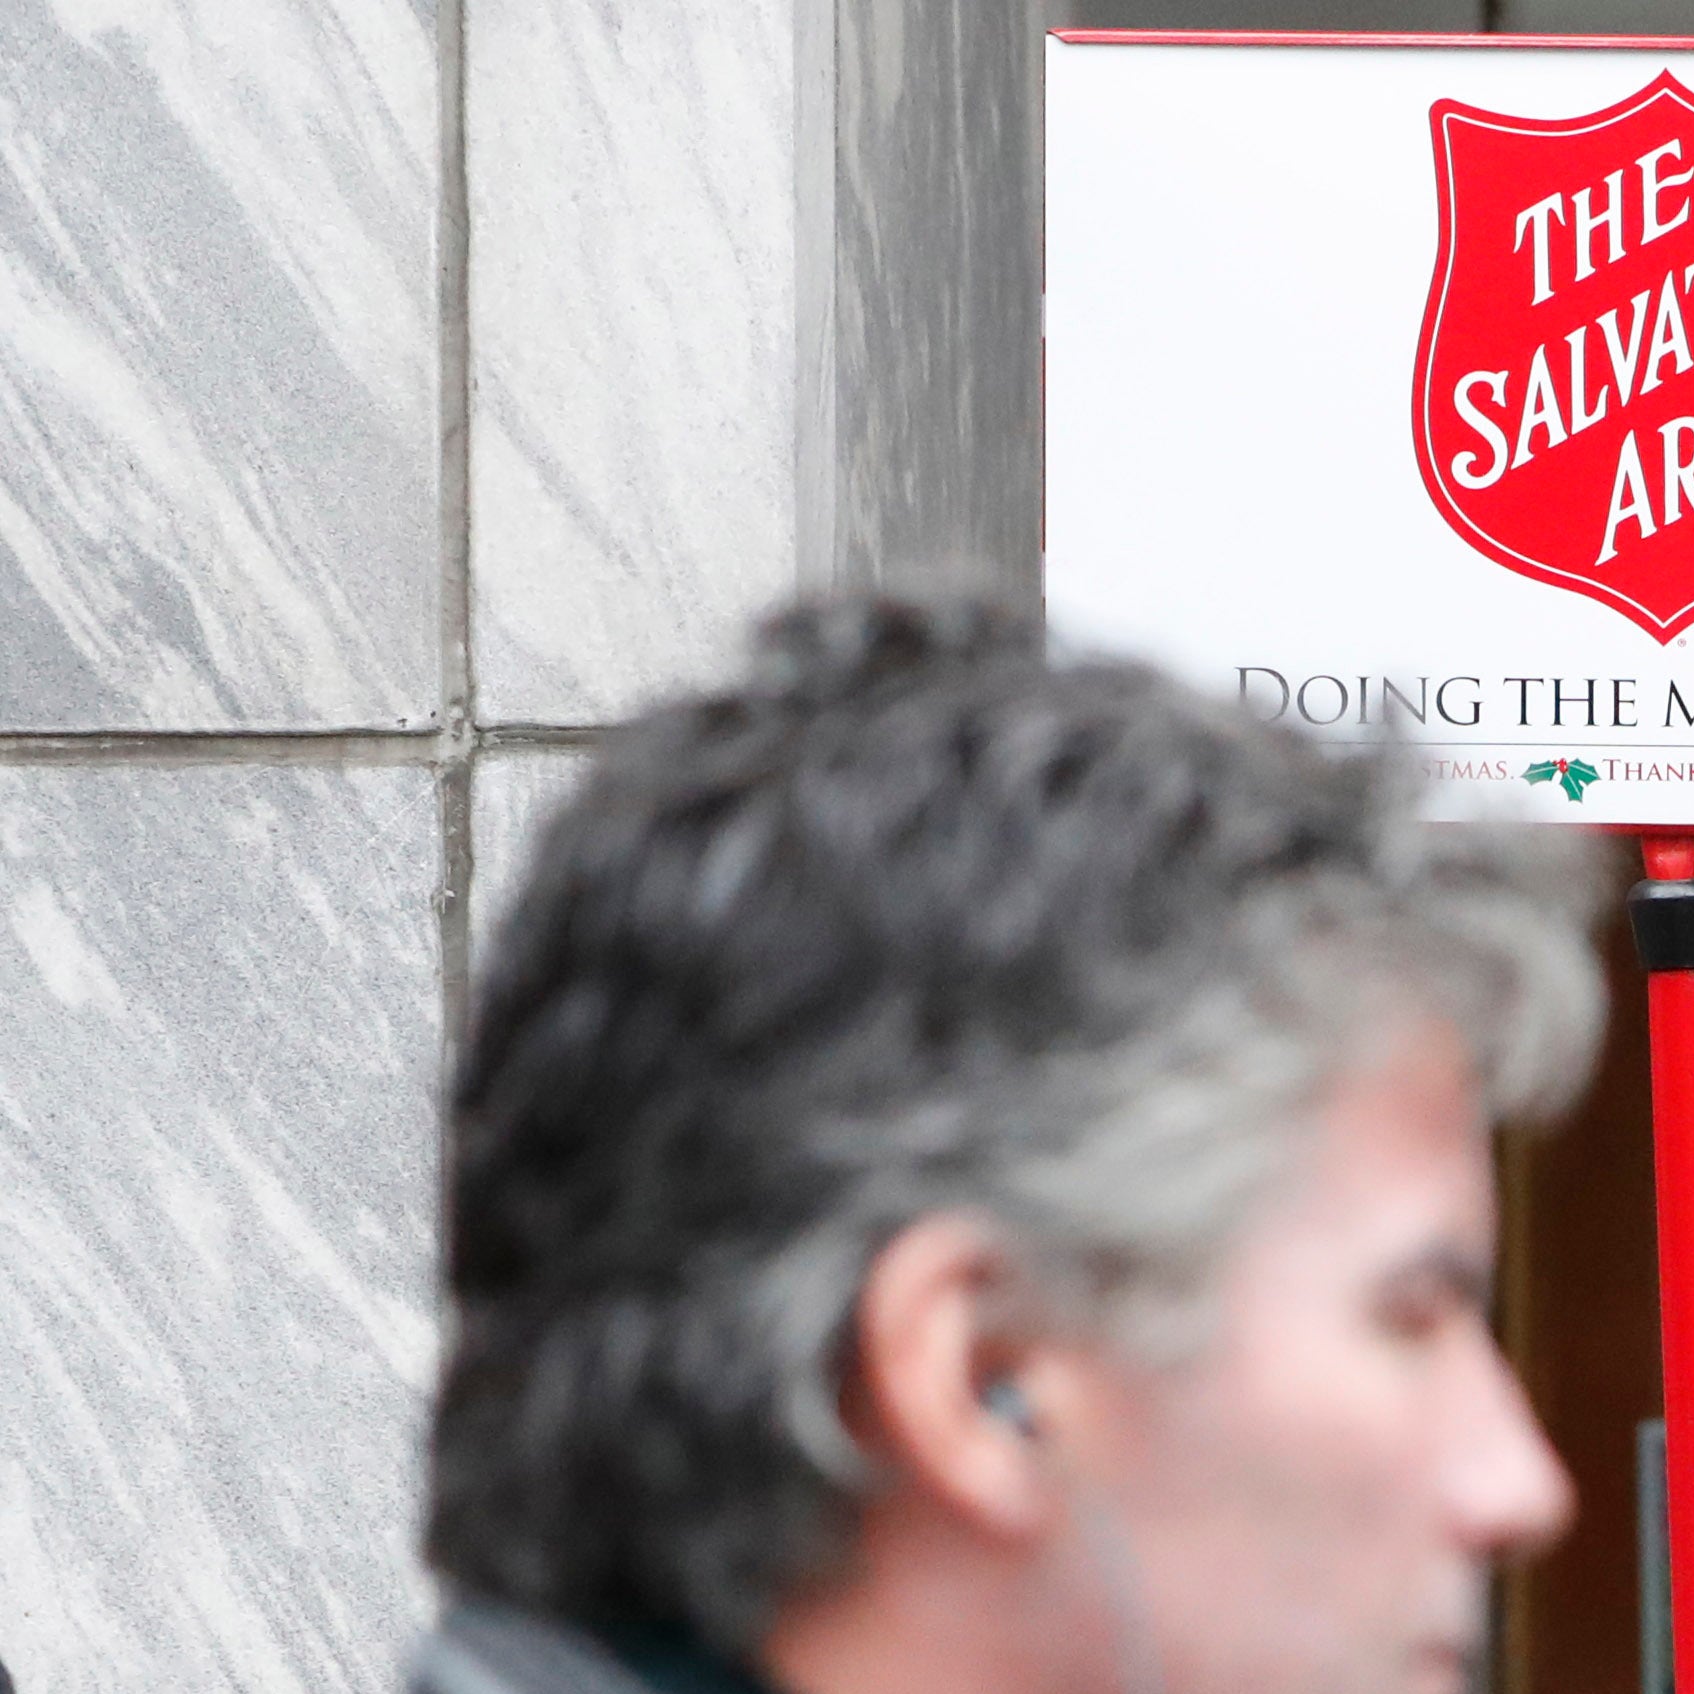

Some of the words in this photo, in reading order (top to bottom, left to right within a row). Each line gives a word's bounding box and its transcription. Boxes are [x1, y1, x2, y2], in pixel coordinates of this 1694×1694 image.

[1513, 138, 1694, 306] THE
[1234, 666, 1482, 726] DOING
[1503, 677, 1638, 727] THE
